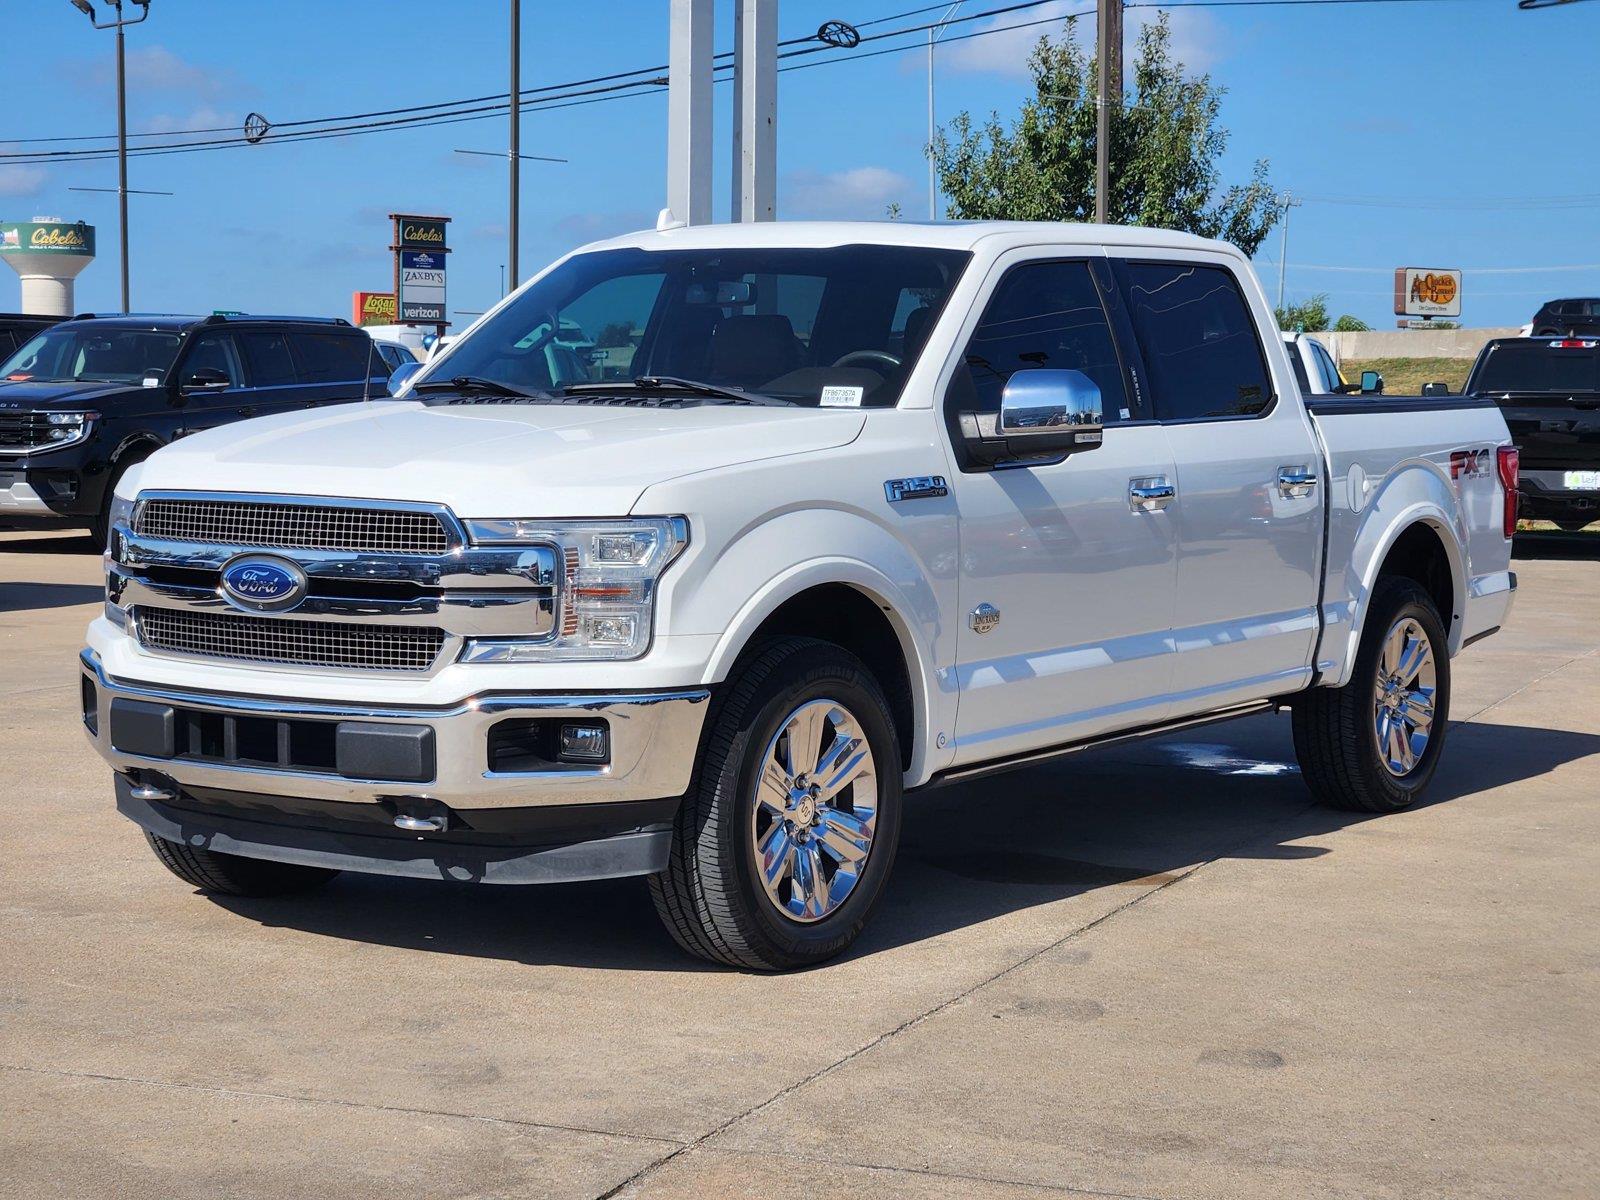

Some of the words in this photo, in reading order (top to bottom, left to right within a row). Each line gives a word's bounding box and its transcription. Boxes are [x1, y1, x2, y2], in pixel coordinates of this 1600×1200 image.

[404, 225, 443, 242] Cabela's
[404, 271, 443, 283] ZAXBY'S
[404, 307, 440, 318] verizon
[1450, 448, 1490, 480] FX4
[238, 569, 279, 593] Ford
